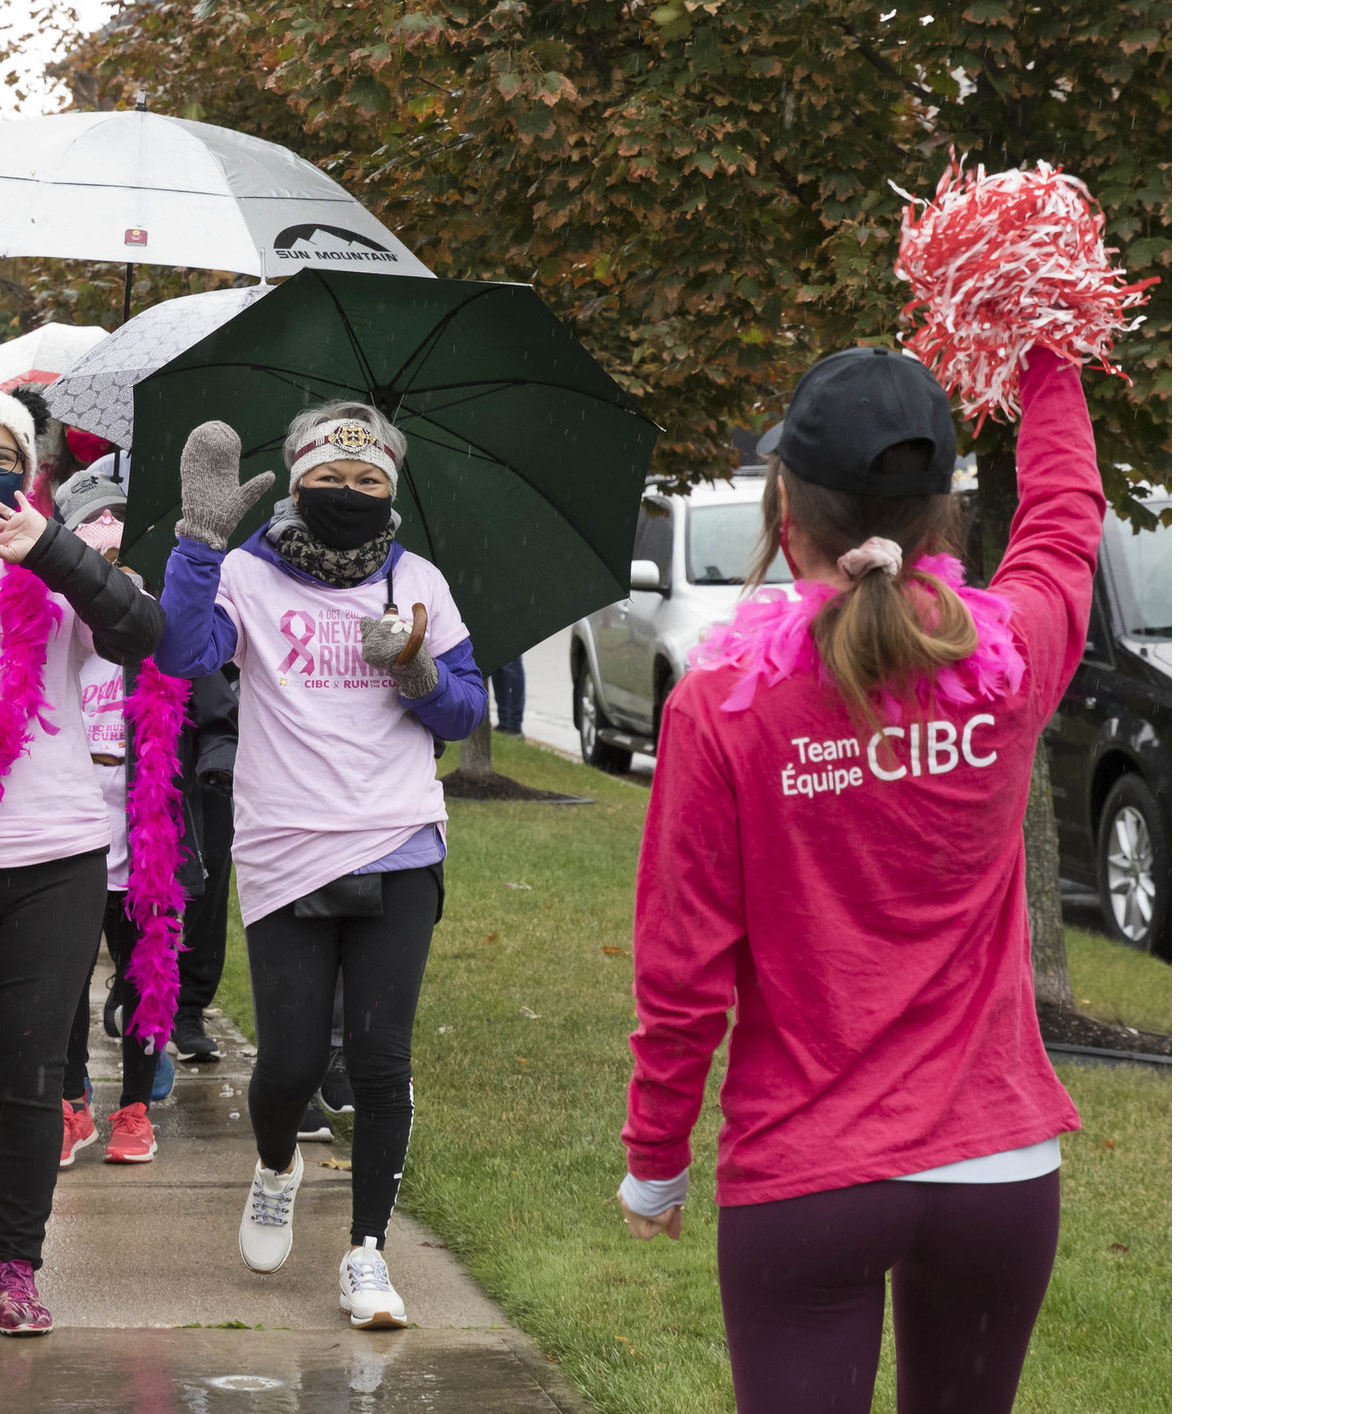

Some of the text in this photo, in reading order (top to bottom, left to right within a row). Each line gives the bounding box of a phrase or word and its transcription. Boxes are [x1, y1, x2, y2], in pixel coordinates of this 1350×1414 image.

[275, 250, 399, 262] SUN MOUNTAIN
[318, 610, 324, 619] 4
[318, 621, 362, 644] NEVE
[304, 680, 369, 689] CIBC RUN
[791, 737, 861, 764] Team
[867, 713, 998, 781] CIBC
[781, 763, 863, 799] Équipe
